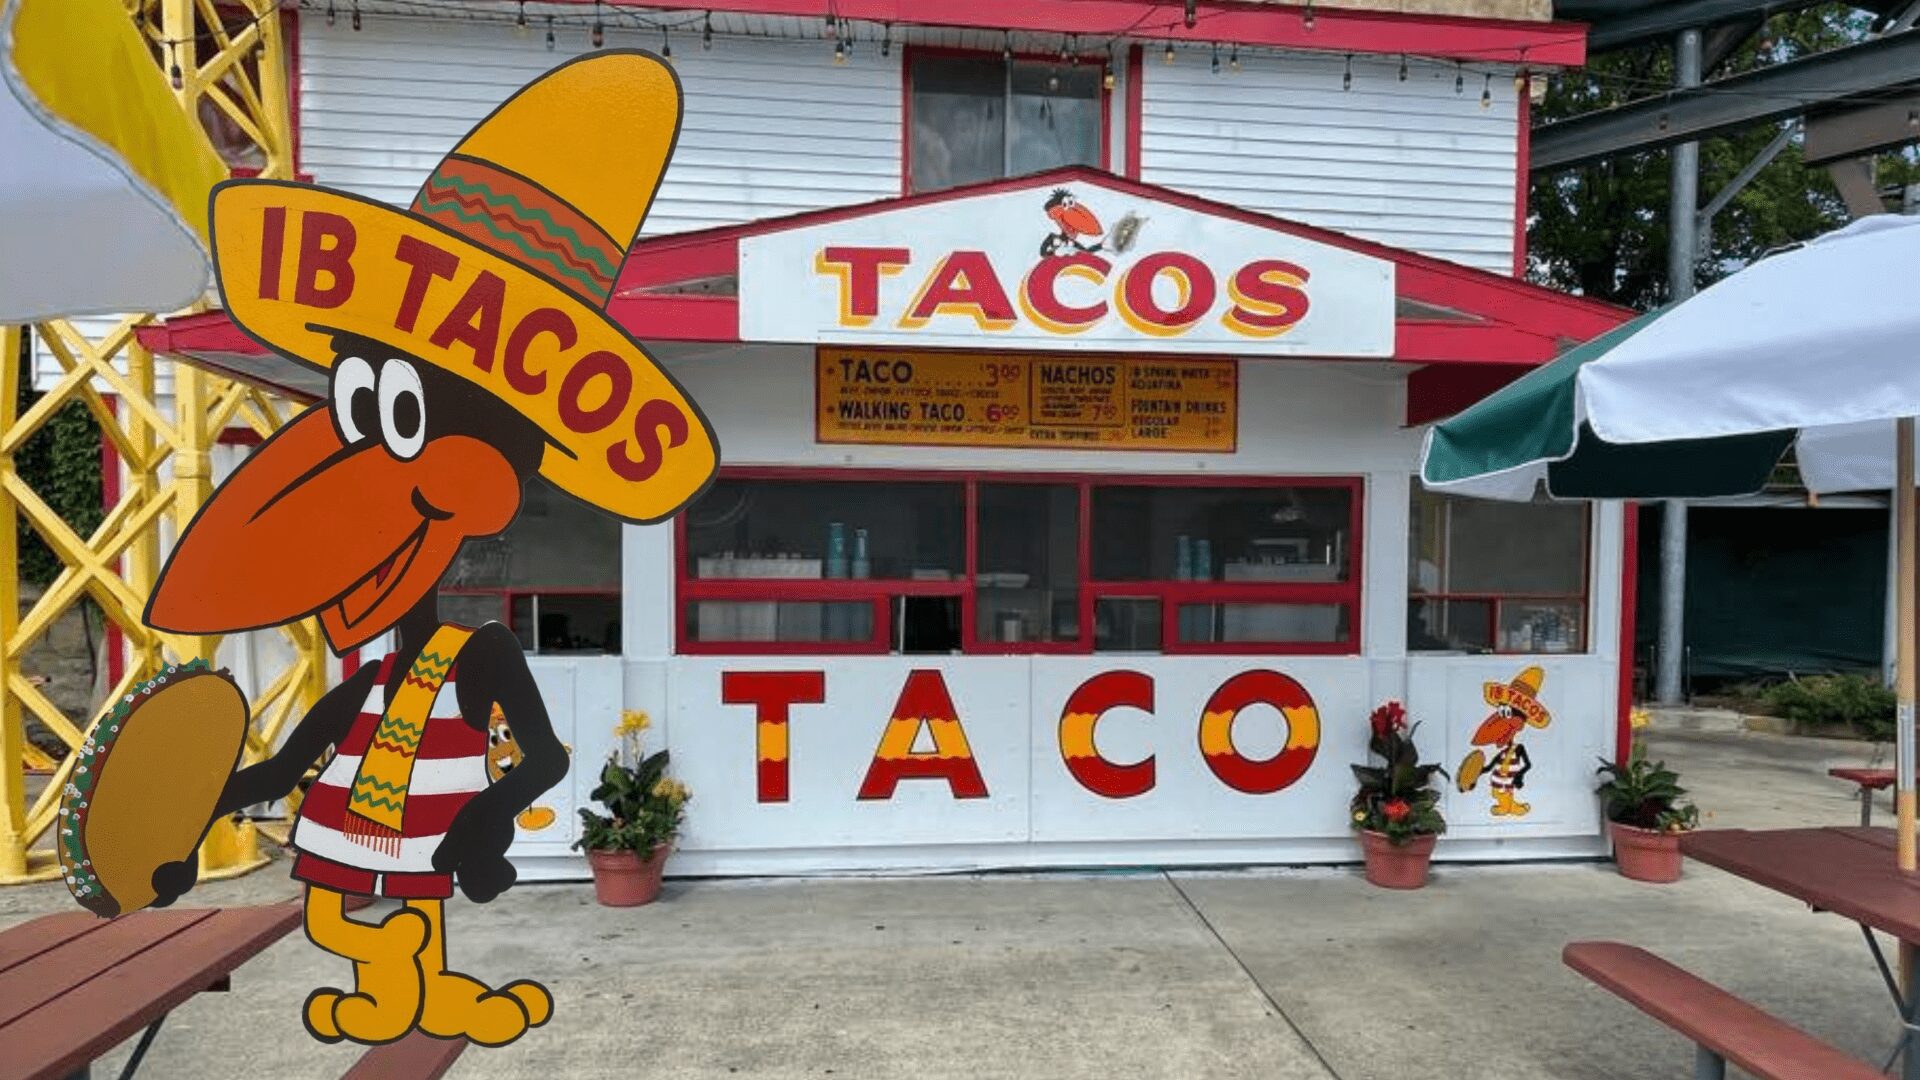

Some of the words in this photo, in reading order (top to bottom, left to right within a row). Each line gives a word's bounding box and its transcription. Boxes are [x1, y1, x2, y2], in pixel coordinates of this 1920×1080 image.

[815, 247, 1311, 338] TACOS
[258, 206, 357, 309] IB
[394, 235, 689, 482] TACOS
[839, 358, 912, 384] TACO
[1040, 365, 1116, 386] NACHOS
[838, 401, 911, 420] WALKING
[1508, 689, 1546, 724] TACOS
[721, 668, 1322, 803] TACO
